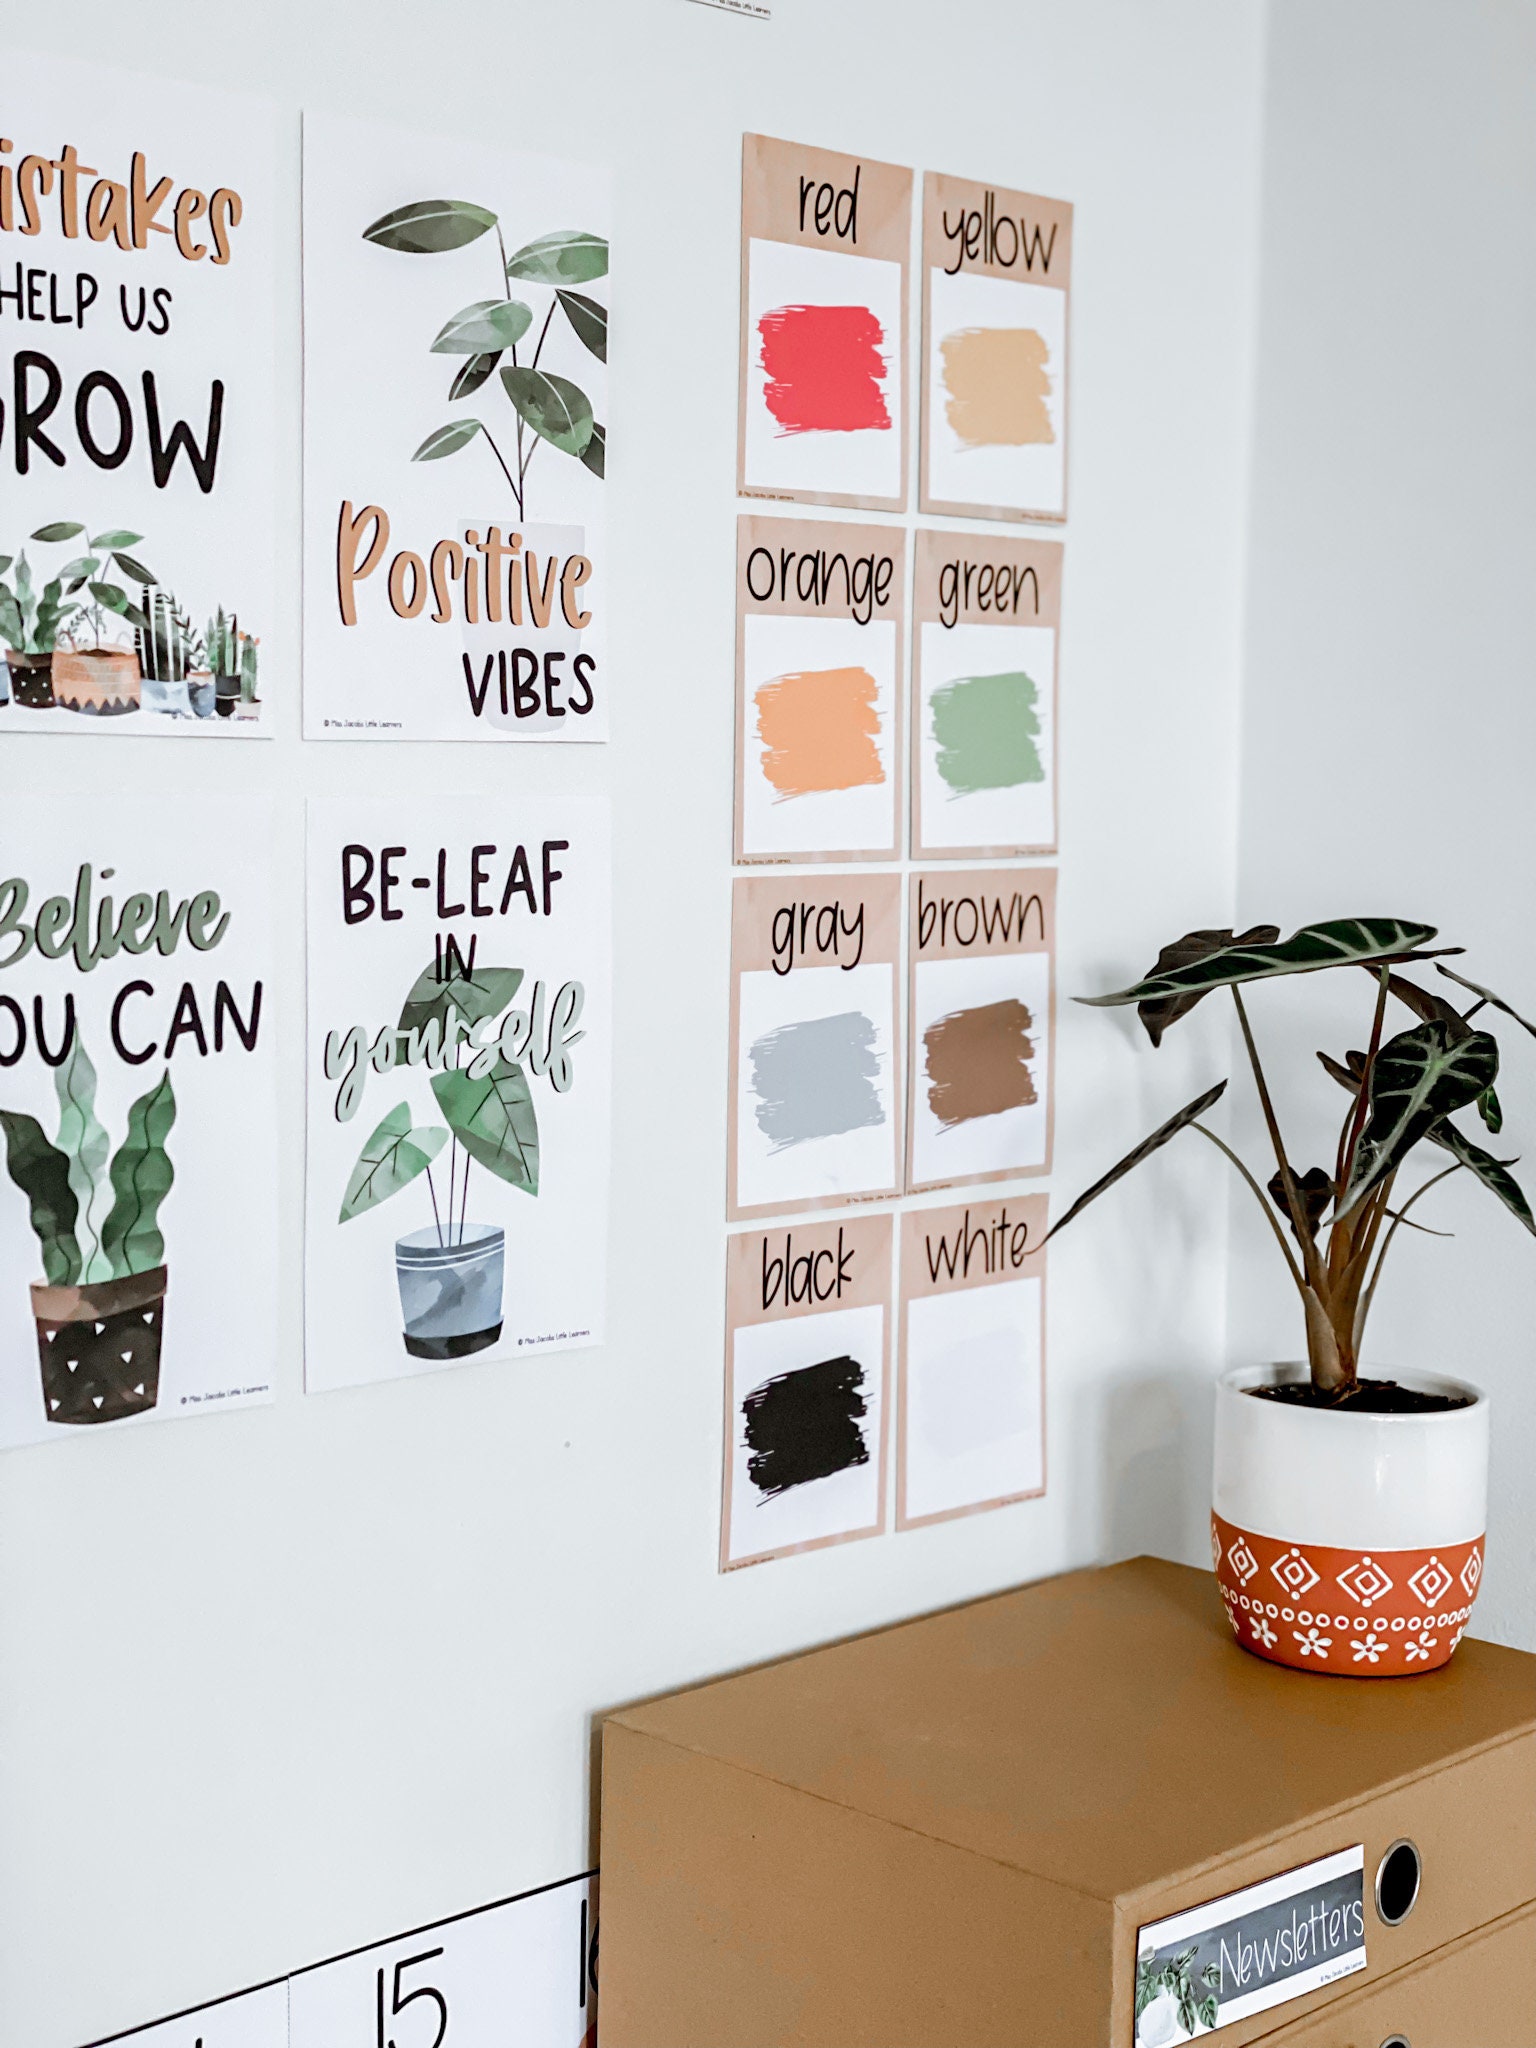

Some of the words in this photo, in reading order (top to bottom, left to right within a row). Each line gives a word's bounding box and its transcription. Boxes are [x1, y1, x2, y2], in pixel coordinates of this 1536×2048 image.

[800, 165, 861, 245] red
[943, 192, 1057, 275] yellow
[119, 284, 173, 336] US
[0, 350, 224, 494] ROW
[337, 500, 593, 629] Positive
[746, 547, 894, 625] orange
[940, 560, 1039, 629] green
[462, 647, 596, 719] VIBES
[0, 862, 231, 972] Believe
[342, 840, 569, 925] BE-LEAF
[919, 880, 1044, 950] brown
[435, 933, 477, 985] IN
[772, 901, 864, 976] gray
[111, 979, 263, 1065] CAN
[324, 980, 587, 1122] yourself
[763, 1227, 855, 1310] black
[926, 1207, 1028, 1284] white
[579, 1899, 600, 2008] 1
[1219, 1900, 1364, 1994] Newsletters
[376, 1946, 448, 2048] 15
